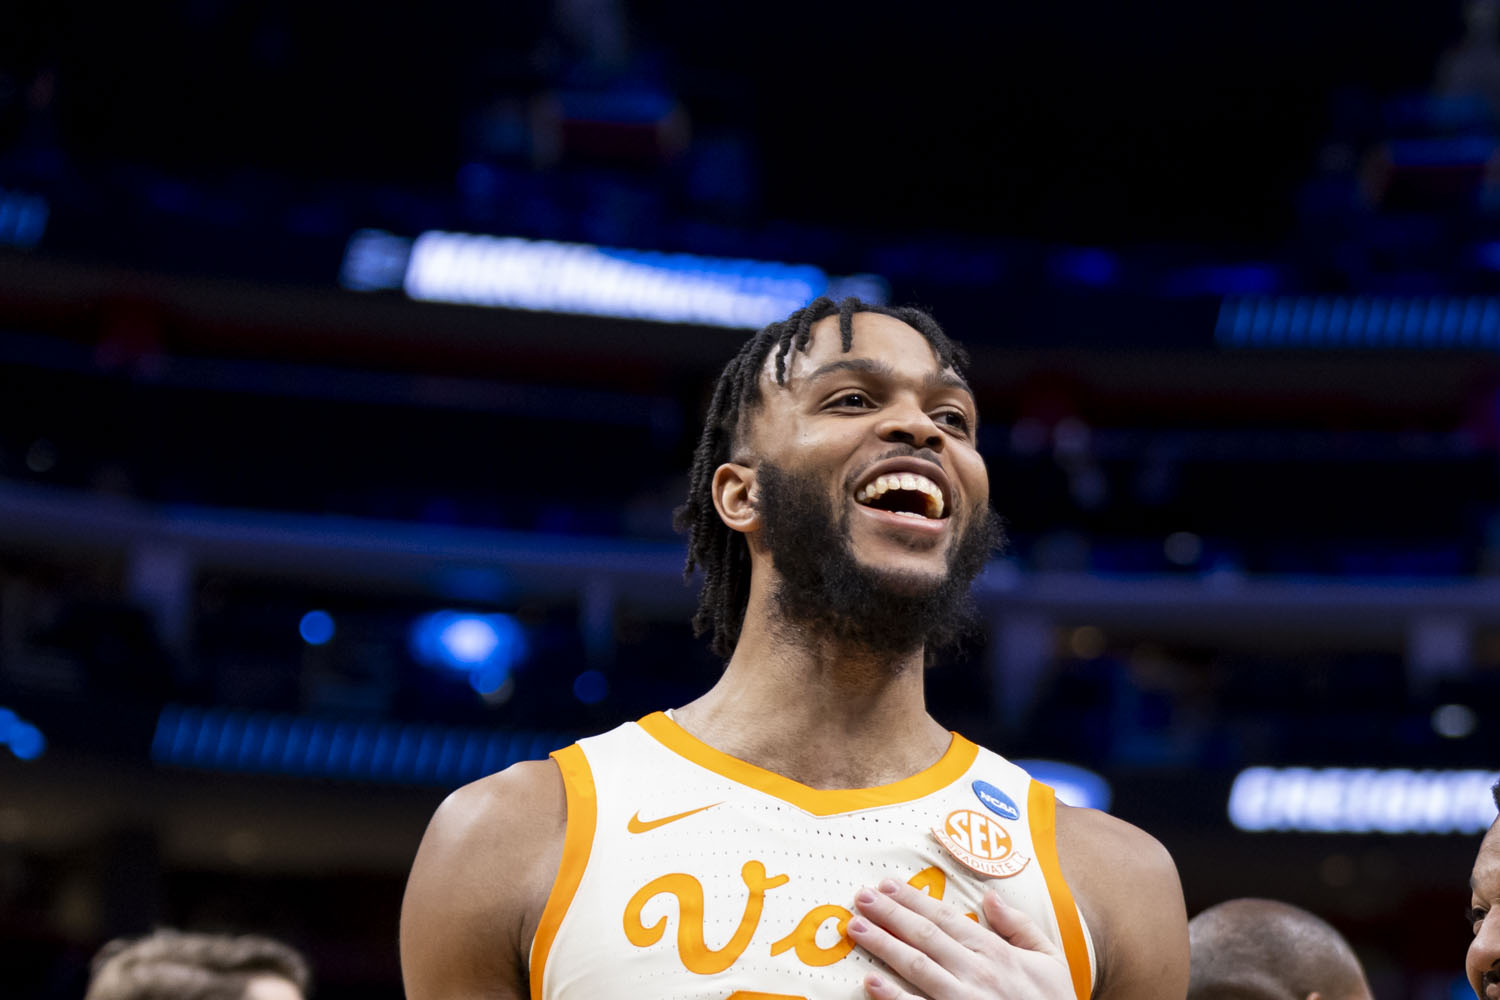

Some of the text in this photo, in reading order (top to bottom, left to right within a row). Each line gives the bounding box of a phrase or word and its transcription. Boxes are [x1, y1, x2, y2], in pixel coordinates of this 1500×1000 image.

[979, 790, 1018, 818] NCAA
[1228, 765, 1500, 834] CREIGHT
[948, 811, 1008, 858] SEC
[622, 859, 979, 975] Vo
